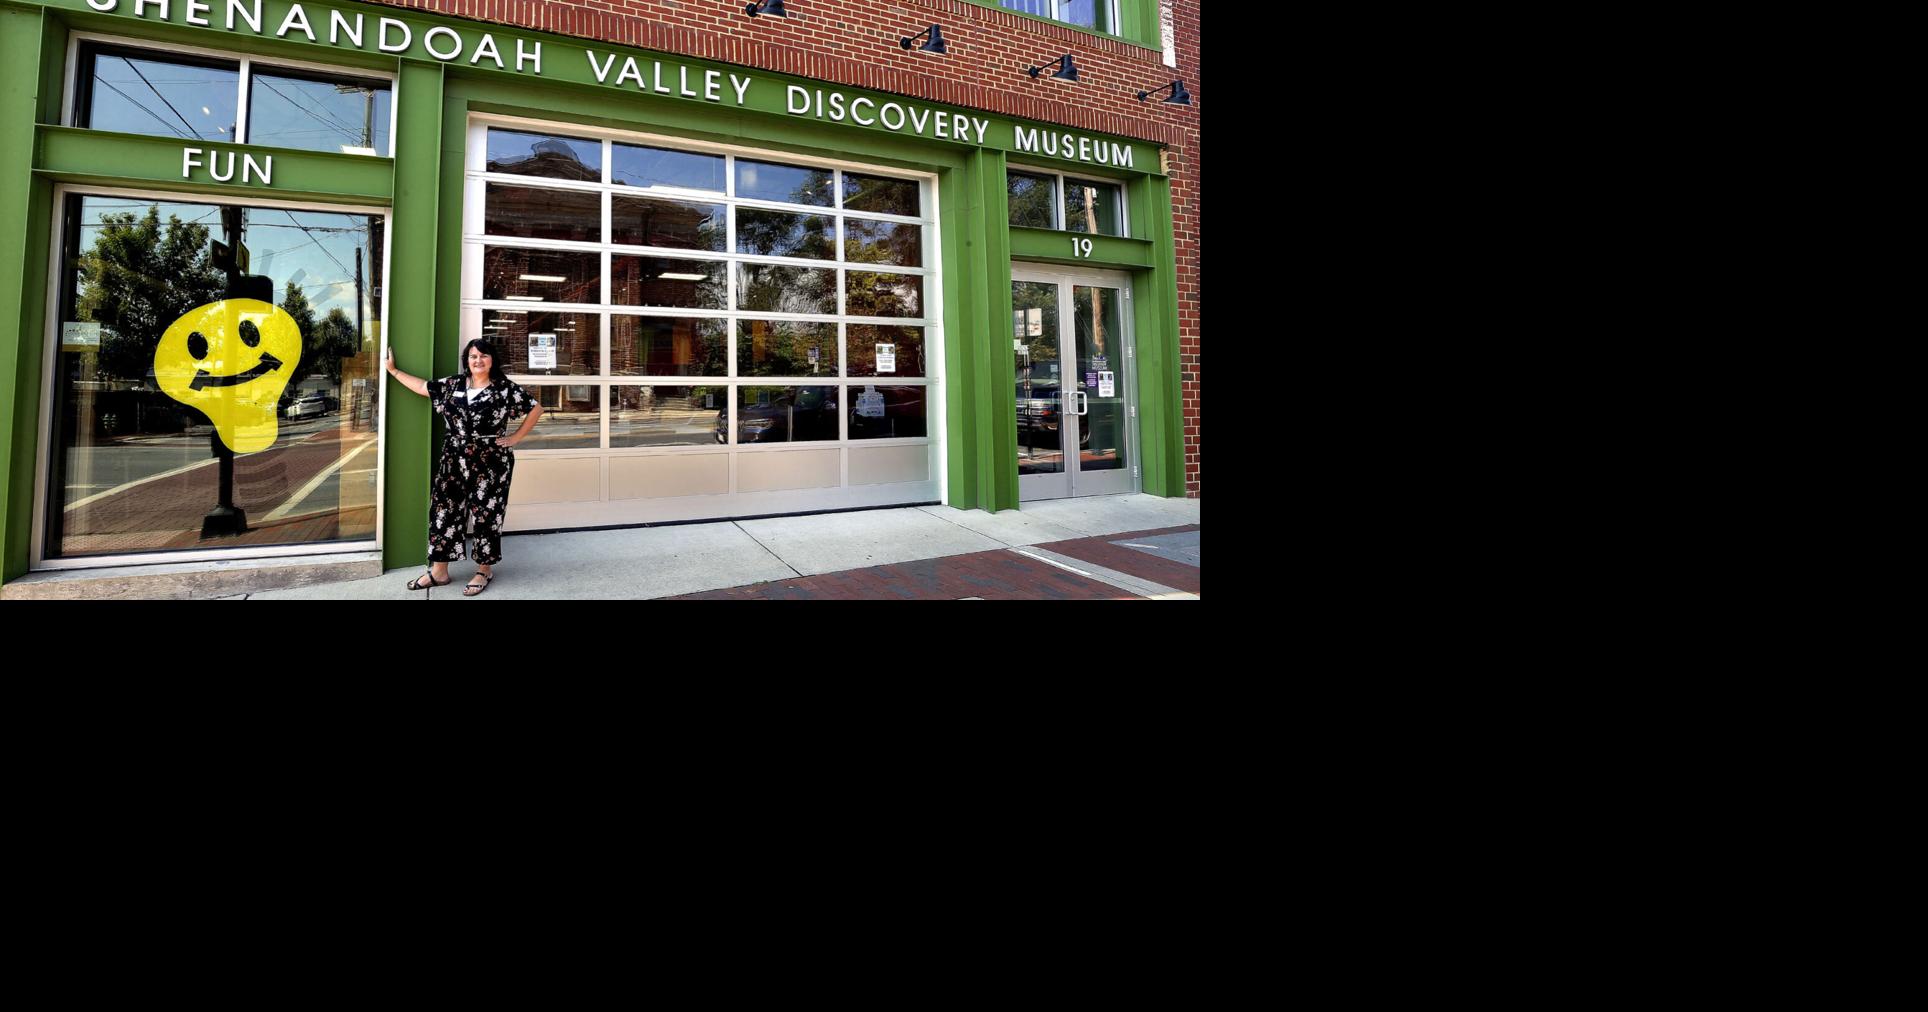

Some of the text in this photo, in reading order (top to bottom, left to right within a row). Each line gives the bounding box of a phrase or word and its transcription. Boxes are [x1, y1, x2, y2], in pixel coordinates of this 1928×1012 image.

[586, 50, 751, 105] VALLEY
[786, 85, 989, 144] DISCOVERY
[1014, 126, 1133, 168] MUSEUM
[182, 147, 272, 185] FUN
[1071, 237, 1093, 258] 19
